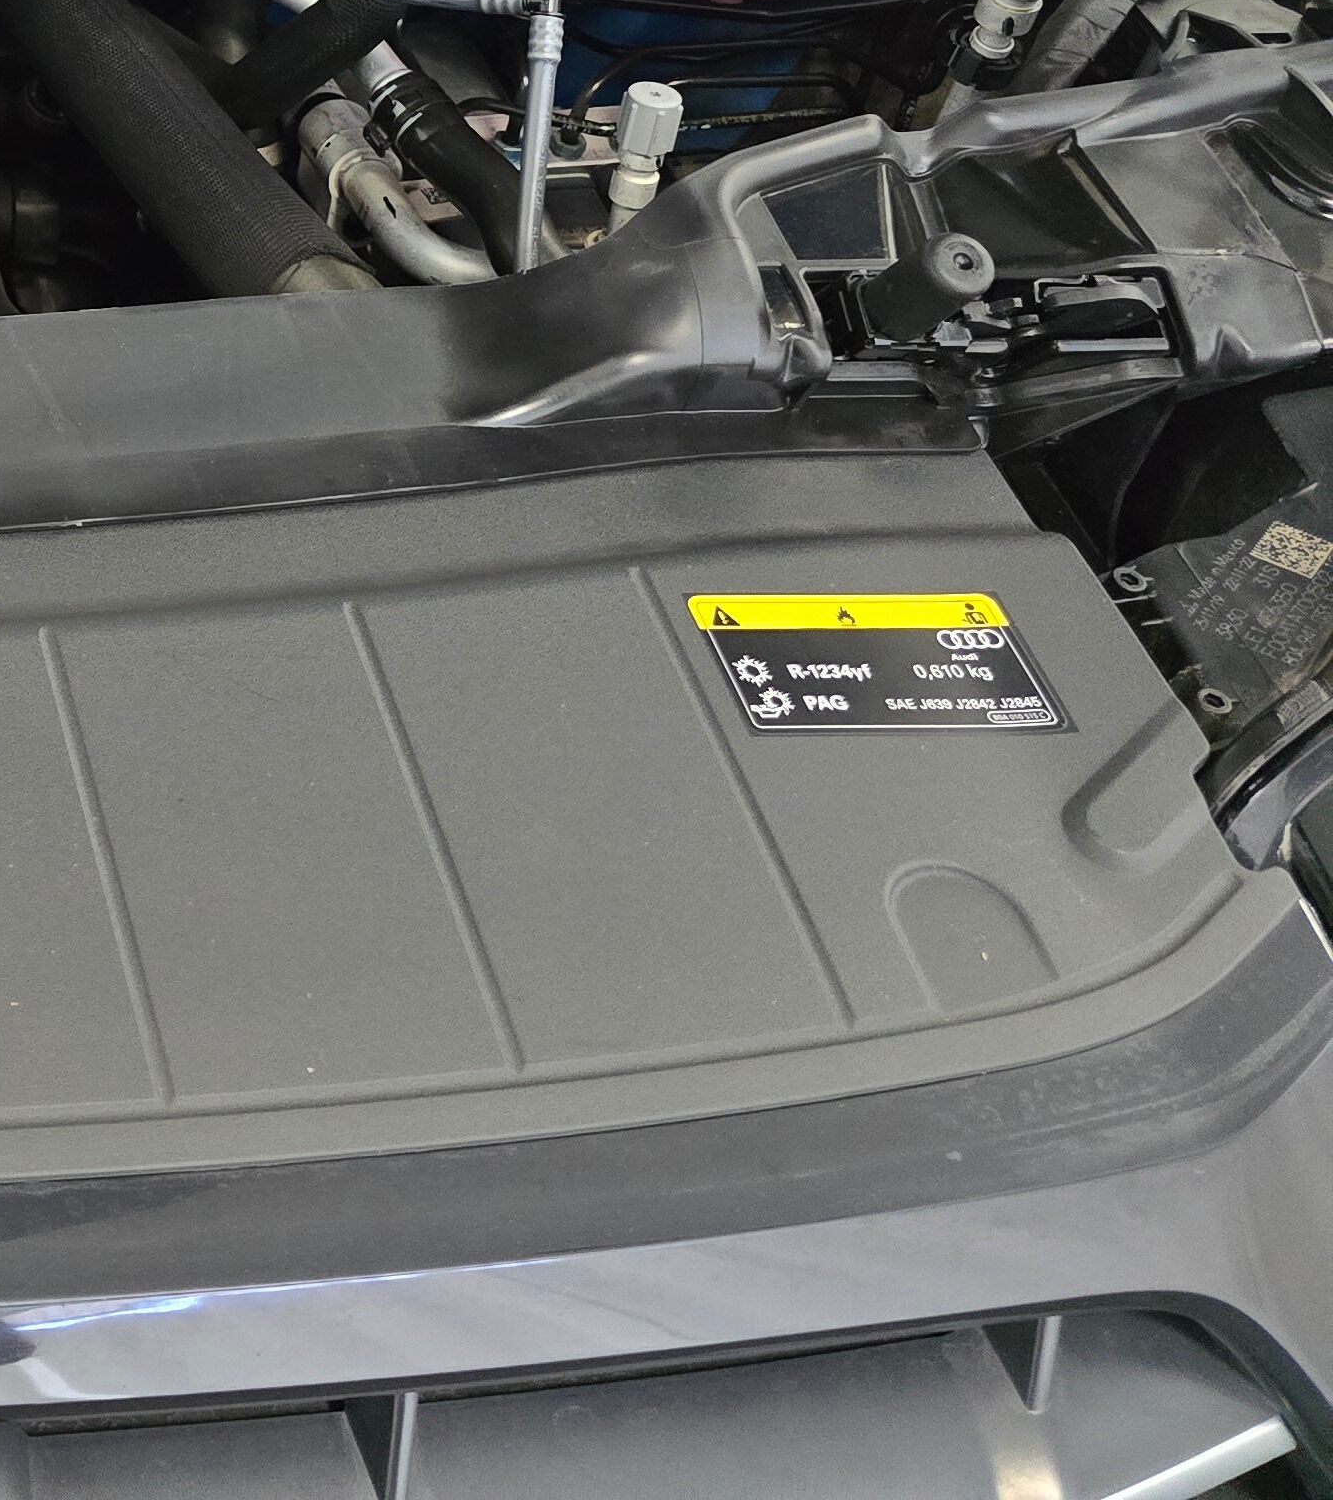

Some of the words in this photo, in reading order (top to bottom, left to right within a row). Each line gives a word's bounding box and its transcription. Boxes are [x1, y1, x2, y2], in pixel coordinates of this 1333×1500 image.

[1212, 538, 1246, 566] Mexico
[951, 653, 979, 661] Audi
[786, 663, 872, 682] R-1234yf
[913, 664, 965, 681] 0,610
[967, 664, 994, 681] kg
[802, 695, 850, 711] PAG
[885, 698, 918, 710] SAE
[919, 698, 953, 710] J639
[955, 698, 997, 710] J2842
[999, 696, 1042, 709] J2845
